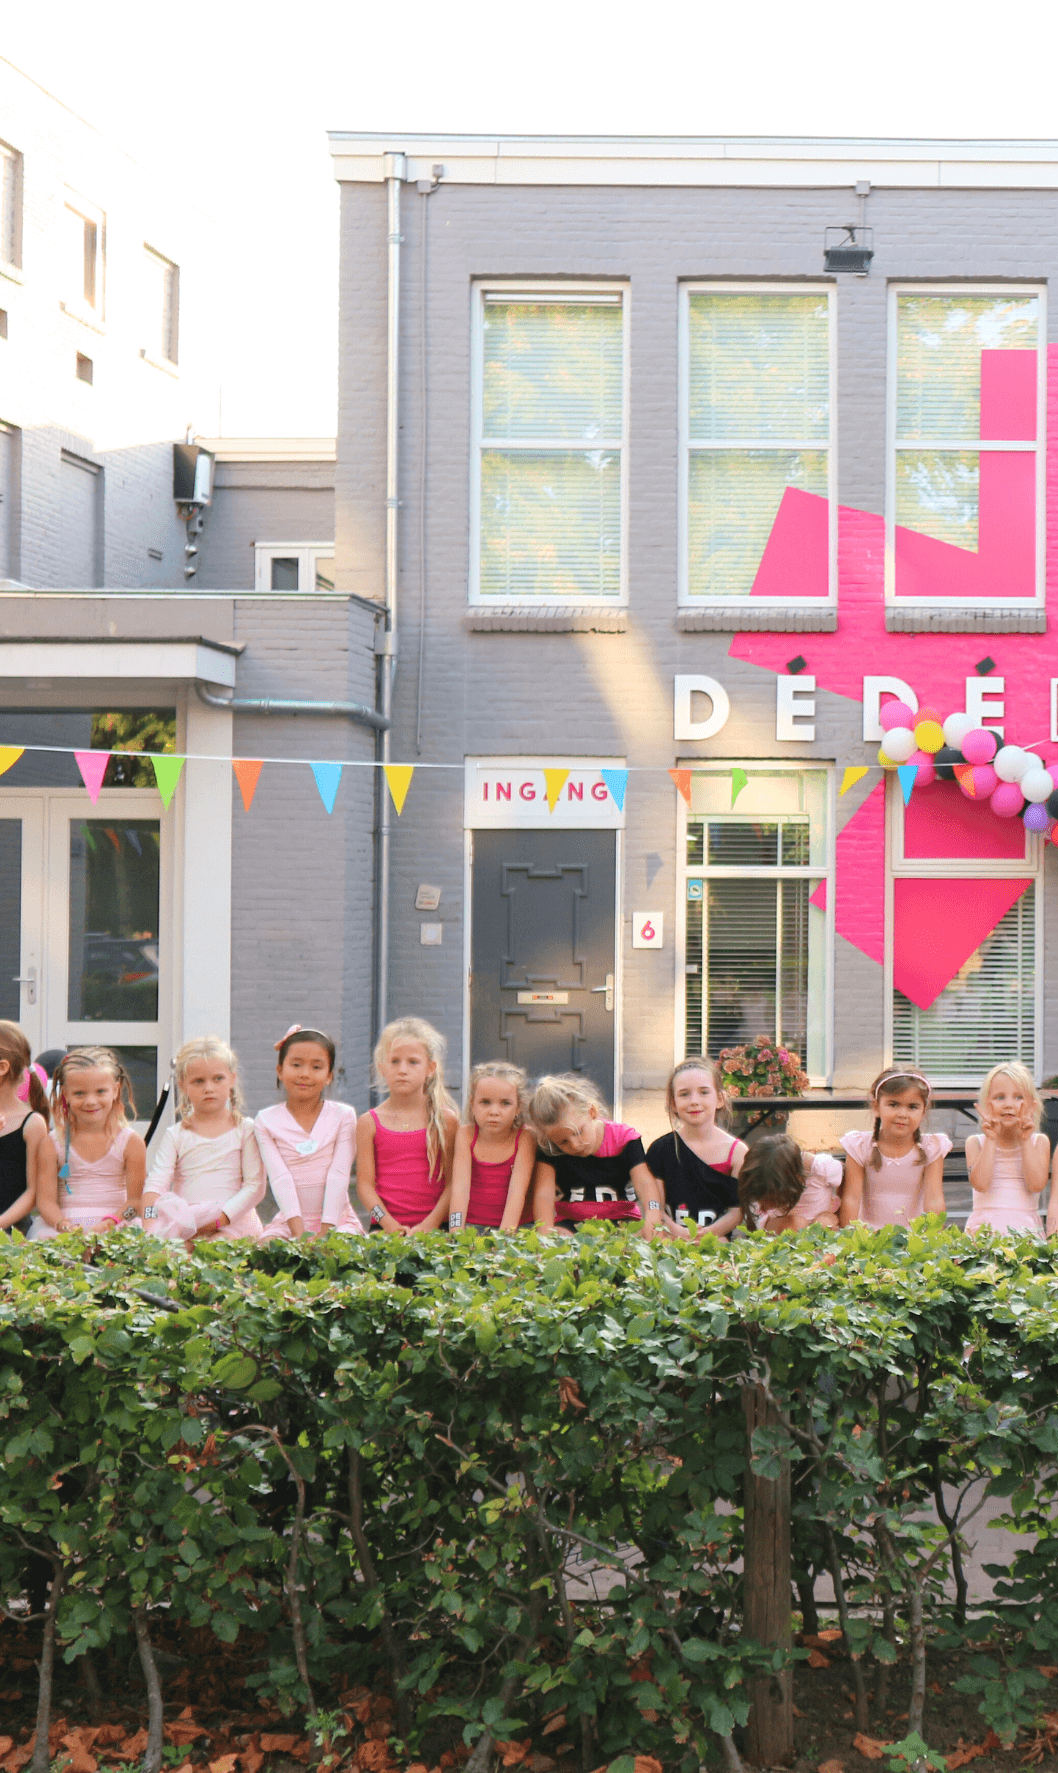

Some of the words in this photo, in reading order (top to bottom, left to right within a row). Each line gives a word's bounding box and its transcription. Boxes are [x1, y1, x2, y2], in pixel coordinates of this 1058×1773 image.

[483, 782, 608, 801] INGNG
[640, 920, 655, 940] 6
[450, 1212, 461, 1220] DE
[450, 1220, 461, 1228] DE
